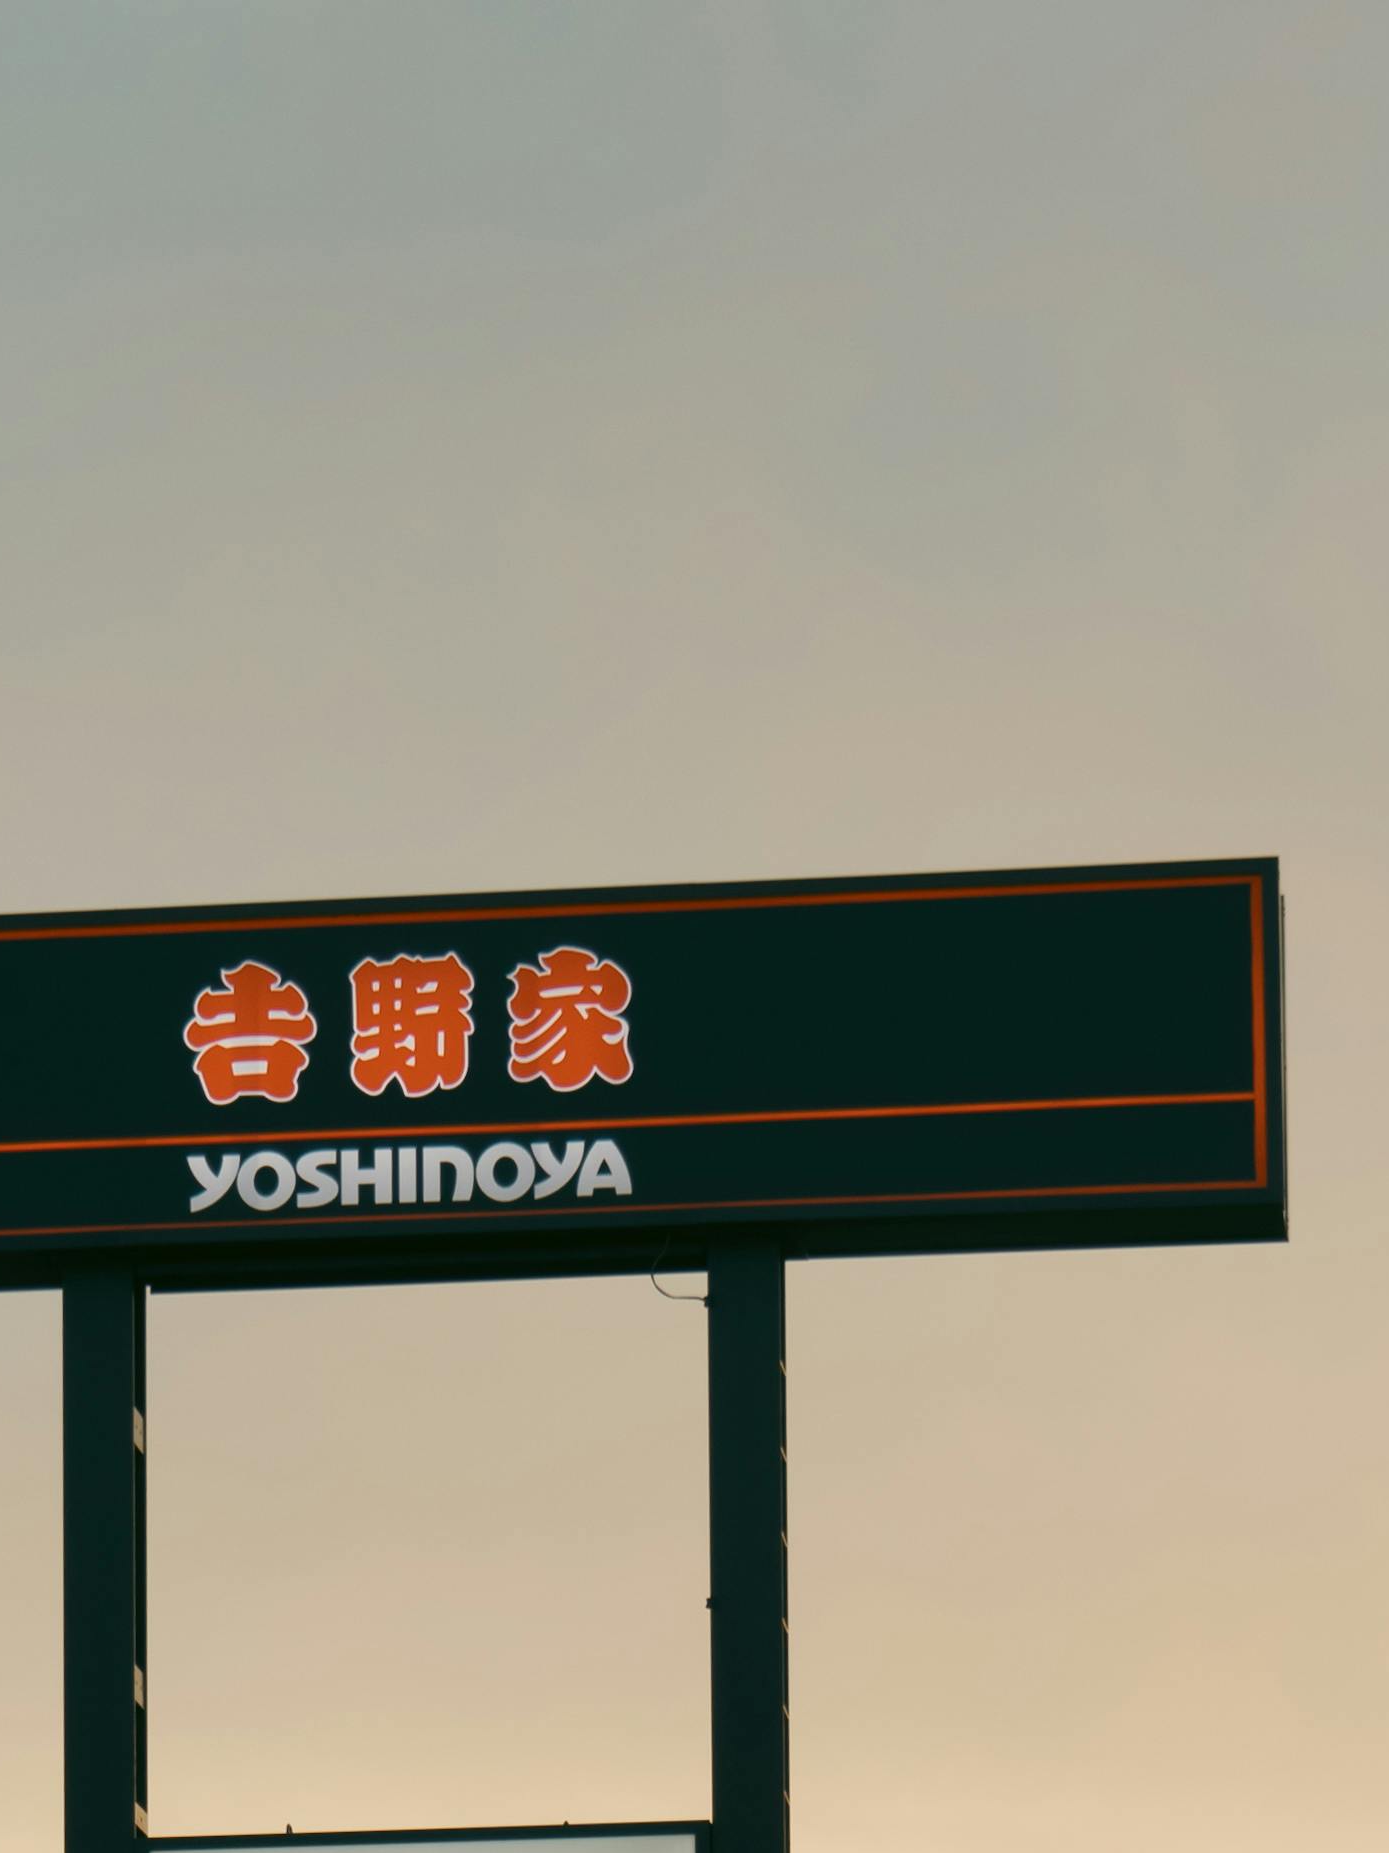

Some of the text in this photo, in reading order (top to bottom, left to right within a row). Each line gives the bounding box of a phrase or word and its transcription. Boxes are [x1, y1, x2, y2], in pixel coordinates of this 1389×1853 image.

[183, 946, 634, 1106] 吉野家
[185, 1138, 633, 1213] YOSHINOYA
